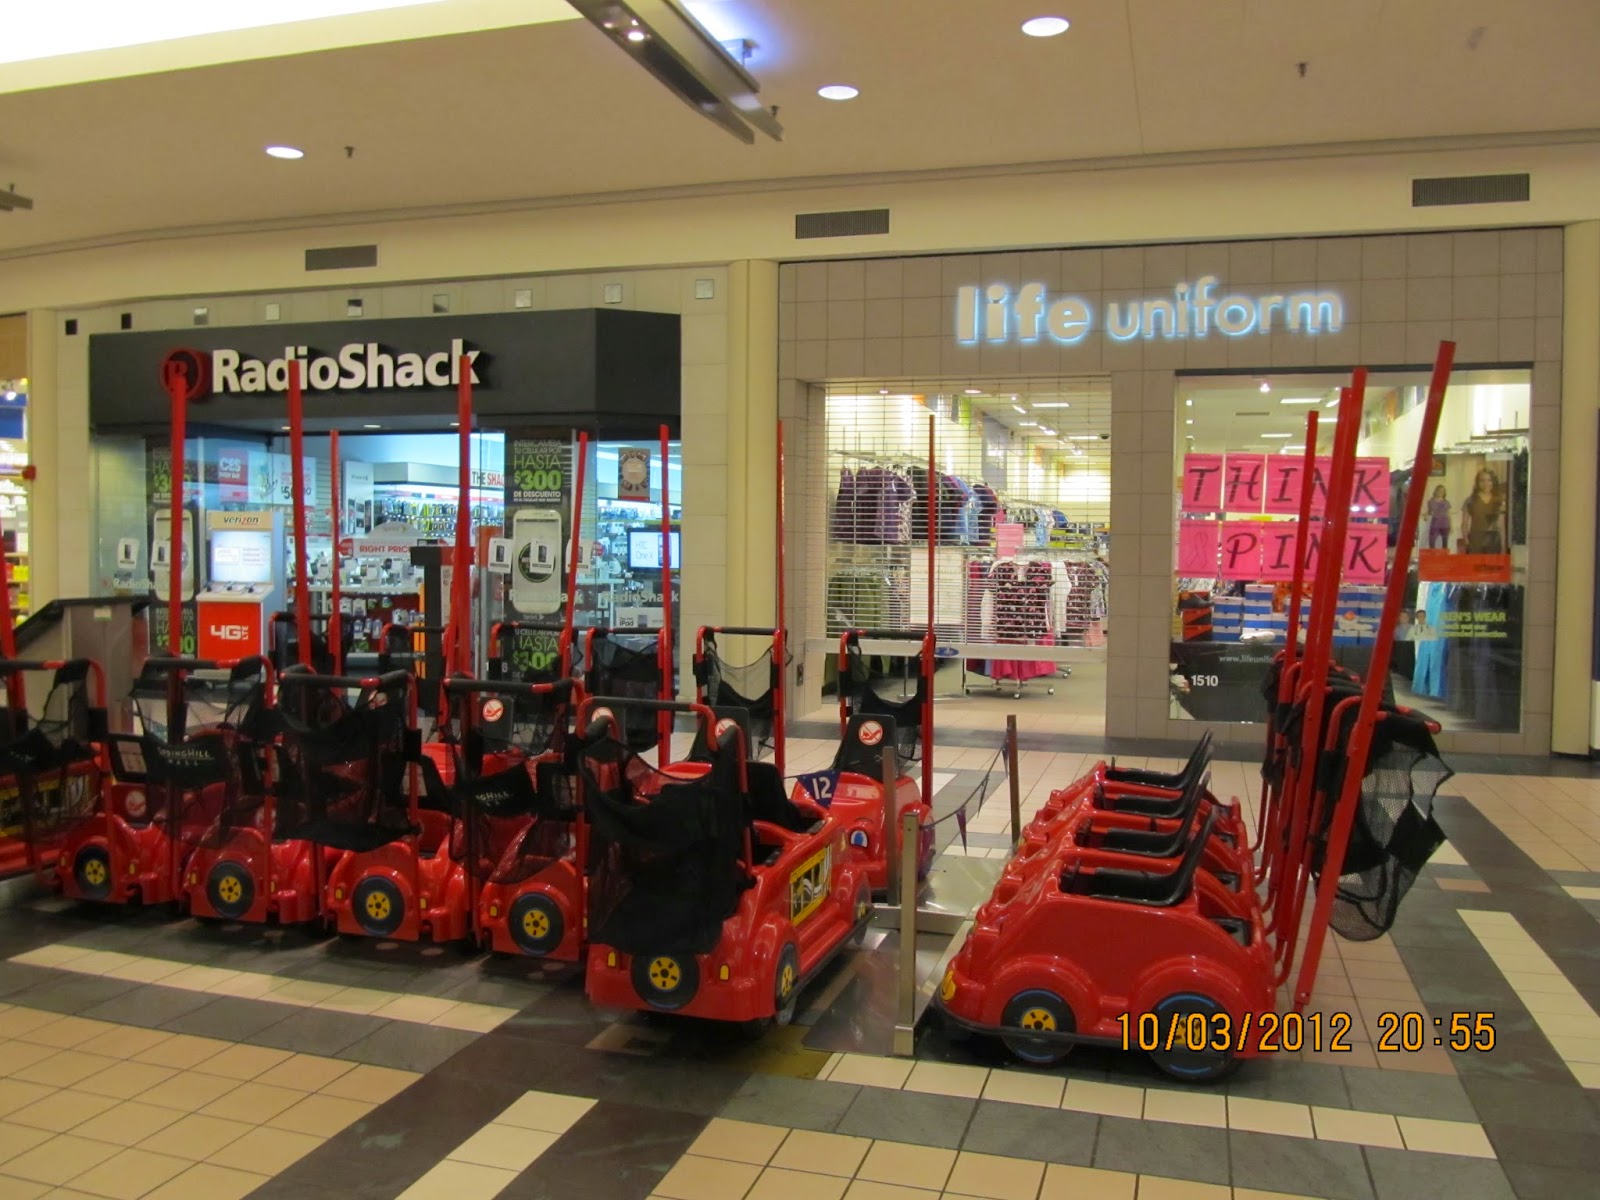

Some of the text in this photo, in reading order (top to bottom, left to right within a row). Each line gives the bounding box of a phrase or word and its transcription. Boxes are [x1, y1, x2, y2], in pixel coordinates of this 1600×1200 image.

[957, 275, 1343, 343] life uniform
[211, 338, 481, 393] RadioShack
[514, 455, 561, 469] HASTA
[472, 471, 485, 485] THE
[514, 470, 562, 491] $300
[223, 515, 259, 525] verizon
[360, 545, 384, 553] RIGHT
[636, 540, 648, 549] HTC
[1474, 611, 1506, 622] WEAR
[211, 625, 241, 640] 4G
[1191, 675, 1218, 687] 1510
[812, 776, 832, 800] 12
